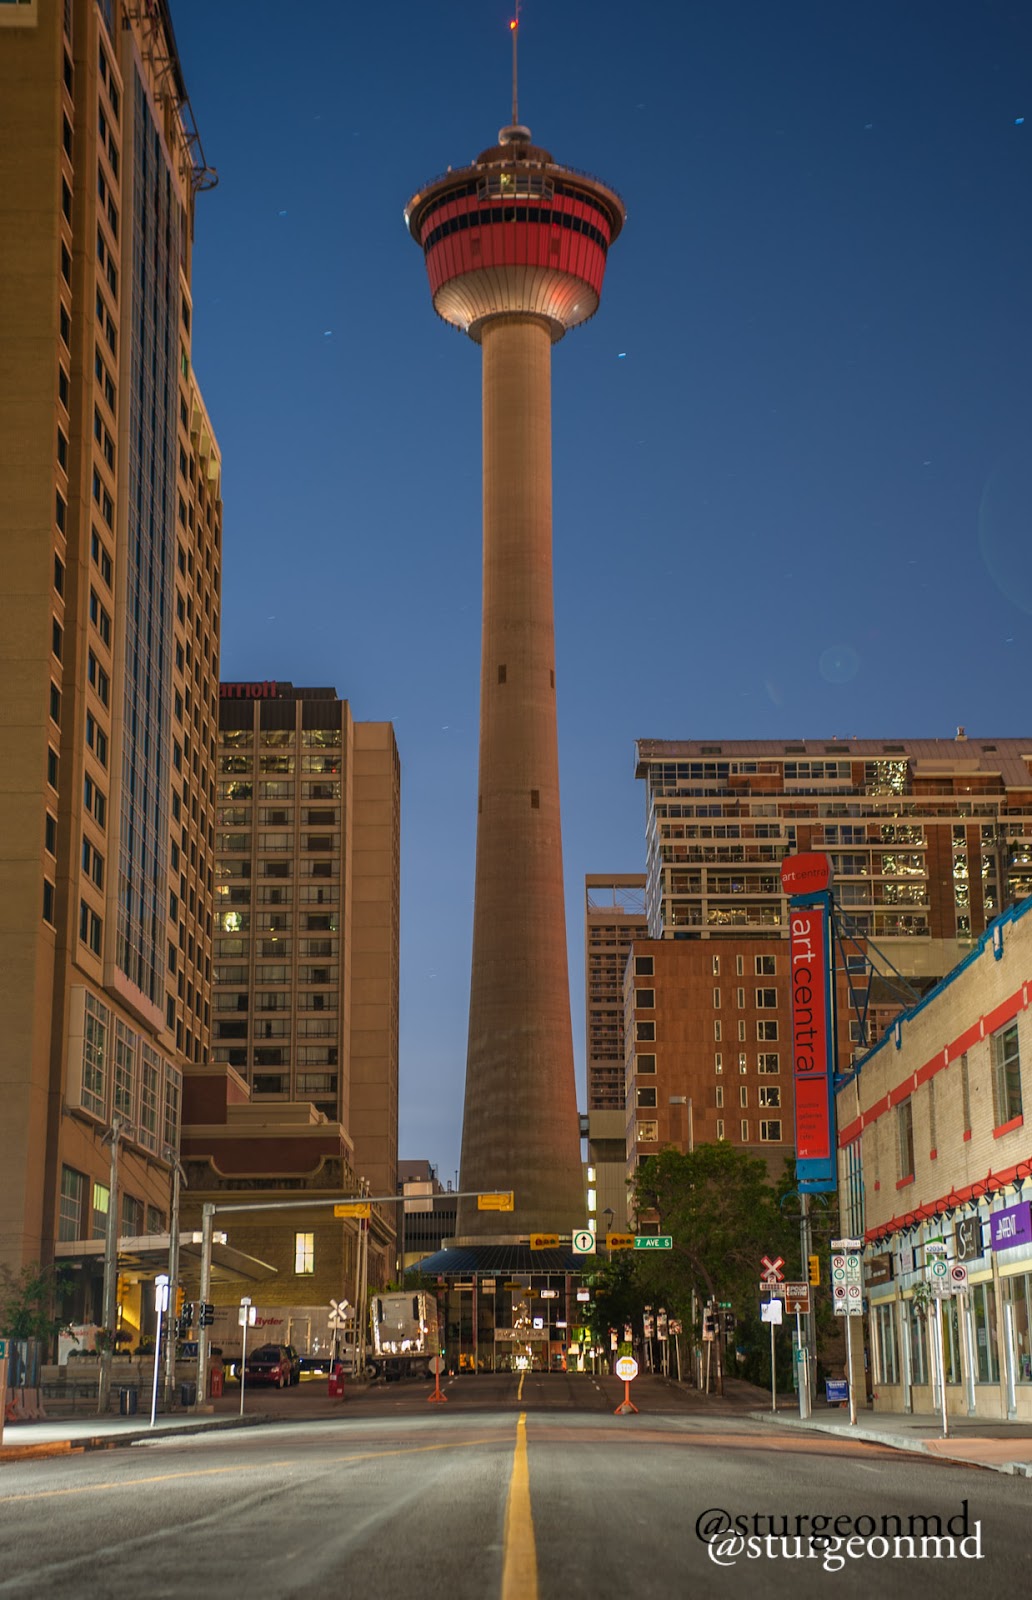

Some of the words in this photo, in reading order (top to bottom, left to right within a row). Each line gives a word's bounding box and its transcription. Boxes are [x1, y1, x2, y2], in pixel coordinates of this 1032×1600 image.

[219, 681, 277, 698] arriott
[636, 1239, 642, 1247] 7
[645, 1239, 660, 1247] AVE
[664, 1239, 670, 1247] S
[769, 1276, 776, 1284] 2
[255, 1317, 284, 1327] Ryder
